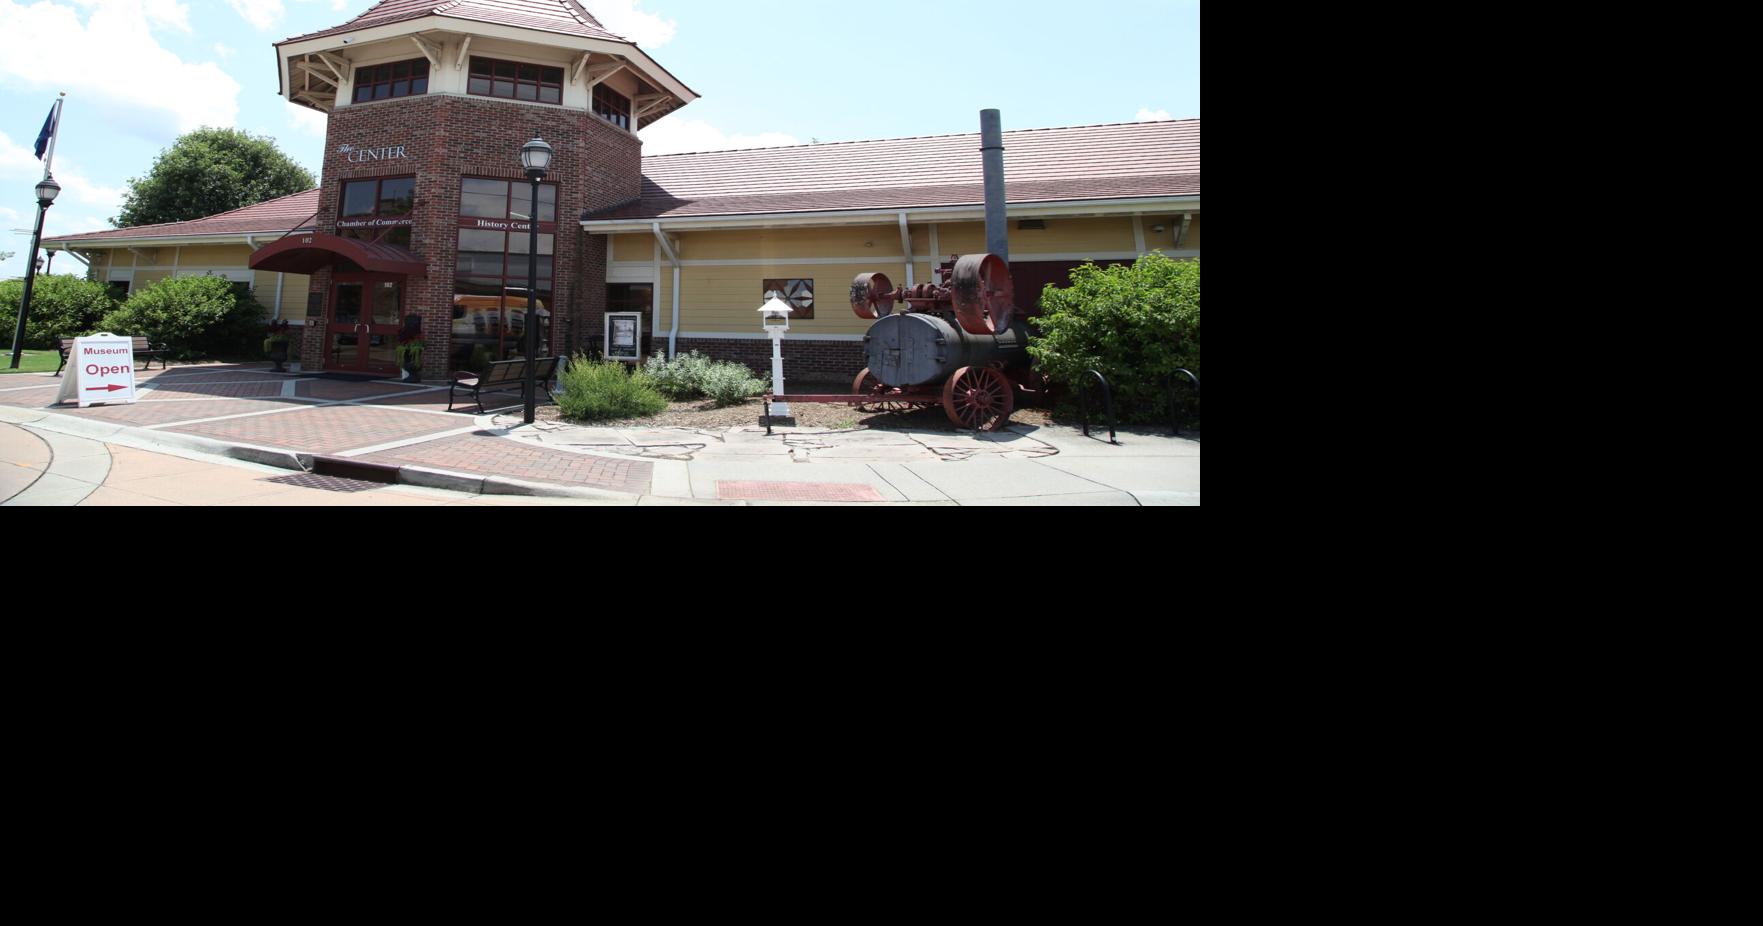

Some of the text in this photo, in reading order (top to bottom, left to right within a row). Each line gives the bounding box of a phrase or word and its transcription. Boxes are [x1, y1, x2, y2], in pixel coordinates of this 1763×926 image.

[347, 145, 407, 163] CENTER
[477, 219, 508, 230] History
[302, 236, 313, 244] 102
[84, 347, 128, 355] Museum
[86, 364, 130, 377] Open
